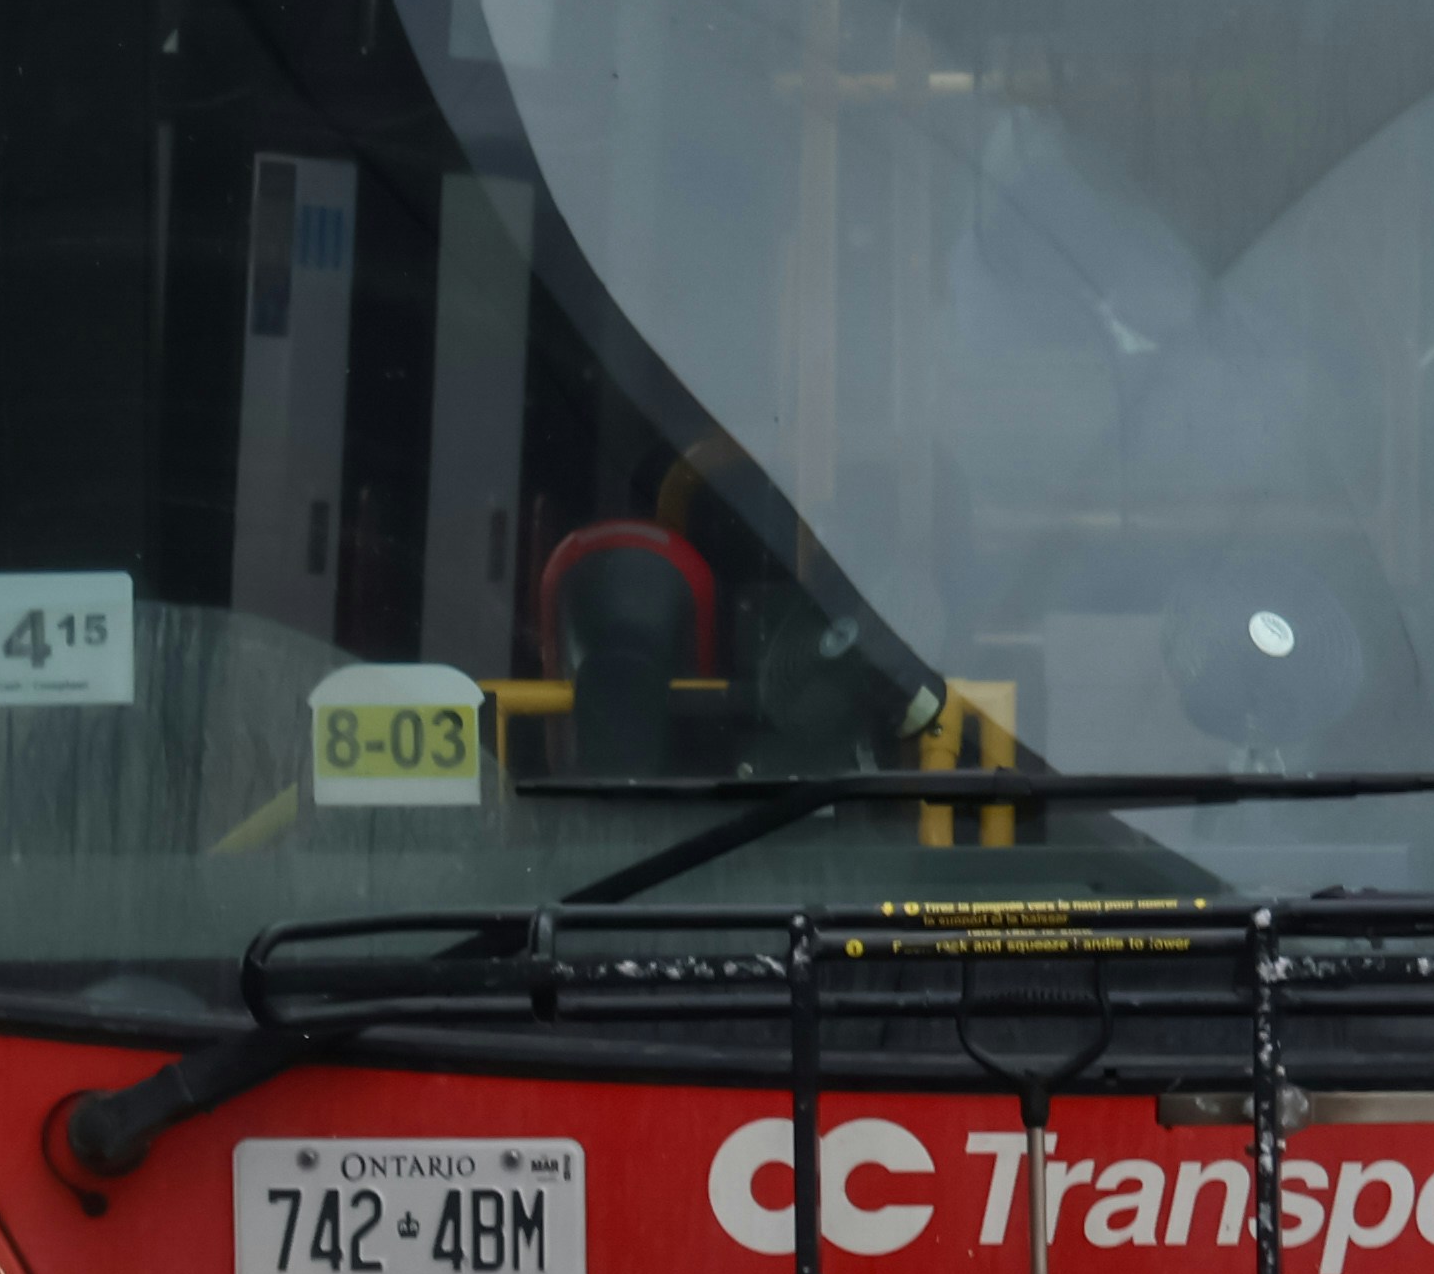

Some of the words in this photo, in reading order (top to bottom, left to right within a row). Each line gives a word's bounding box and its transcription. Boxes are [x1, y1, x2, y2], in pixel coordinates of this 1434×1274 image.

[325, 708, 467, 771] 8-03
[340, 1152, 476, 1182] ONTARIO
[268, 1188, 383, 1272] 742
[432, 1188, 546, 1272] 4BM
